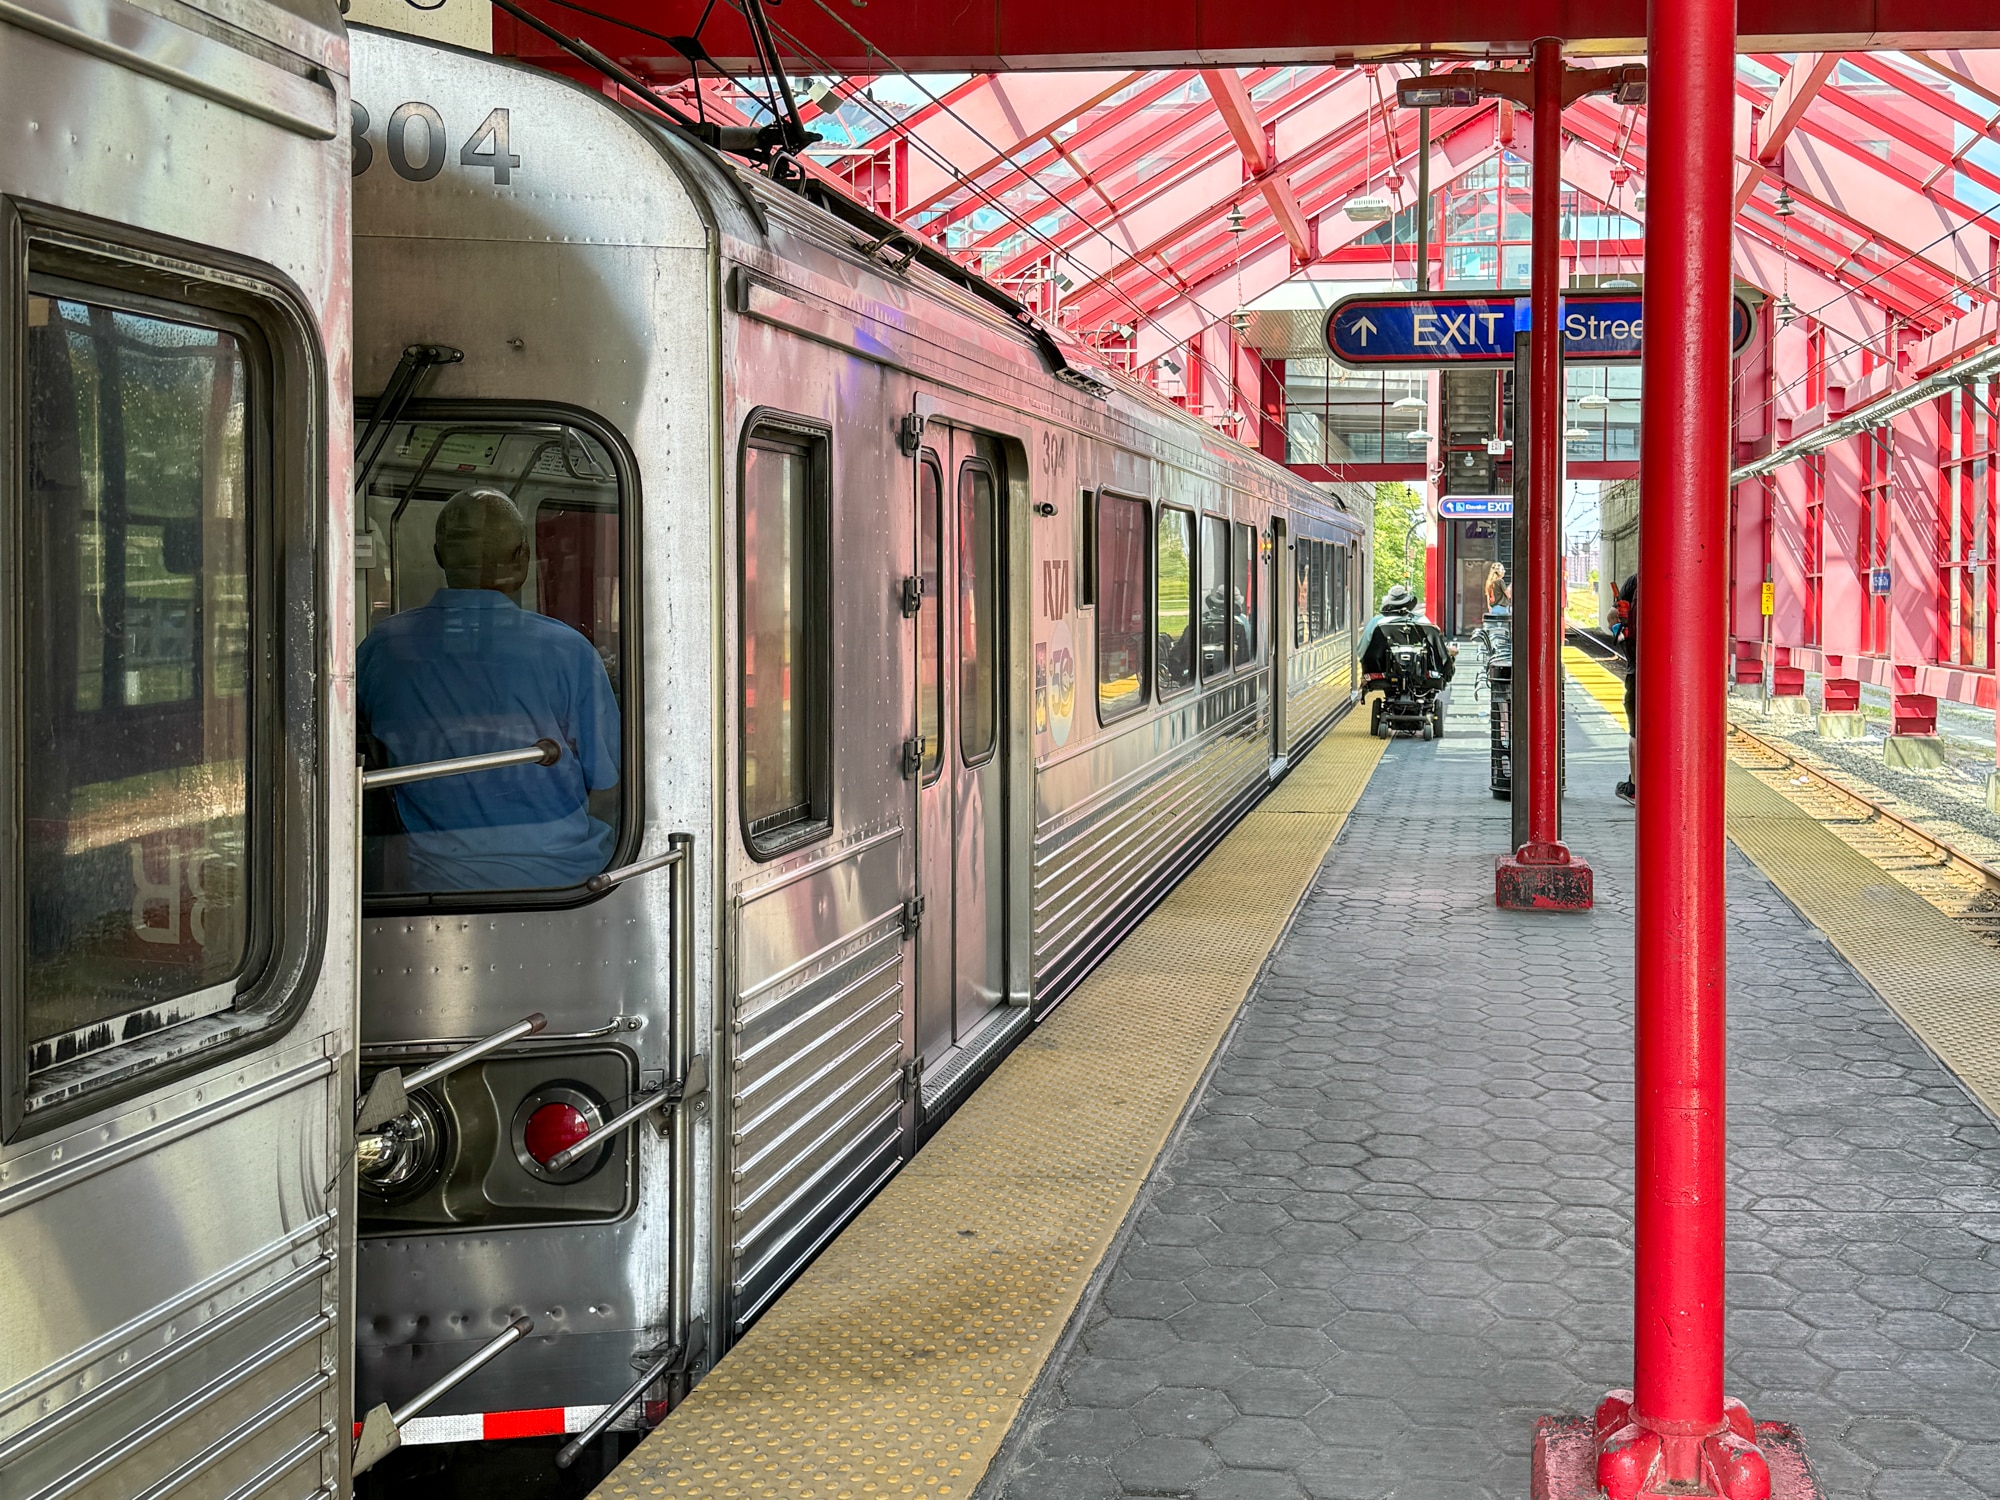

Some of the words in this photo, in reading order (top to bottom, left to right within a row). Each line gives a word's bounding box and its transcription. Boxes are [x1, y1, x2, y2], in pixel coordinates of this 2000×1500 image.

[1413, 312, 1504, 346] EXIT
[1043, 430, 1065, 479] 304
[1487, 502, 1511, 511] EXIT
[1043, 559, 1069, 621] RTA
